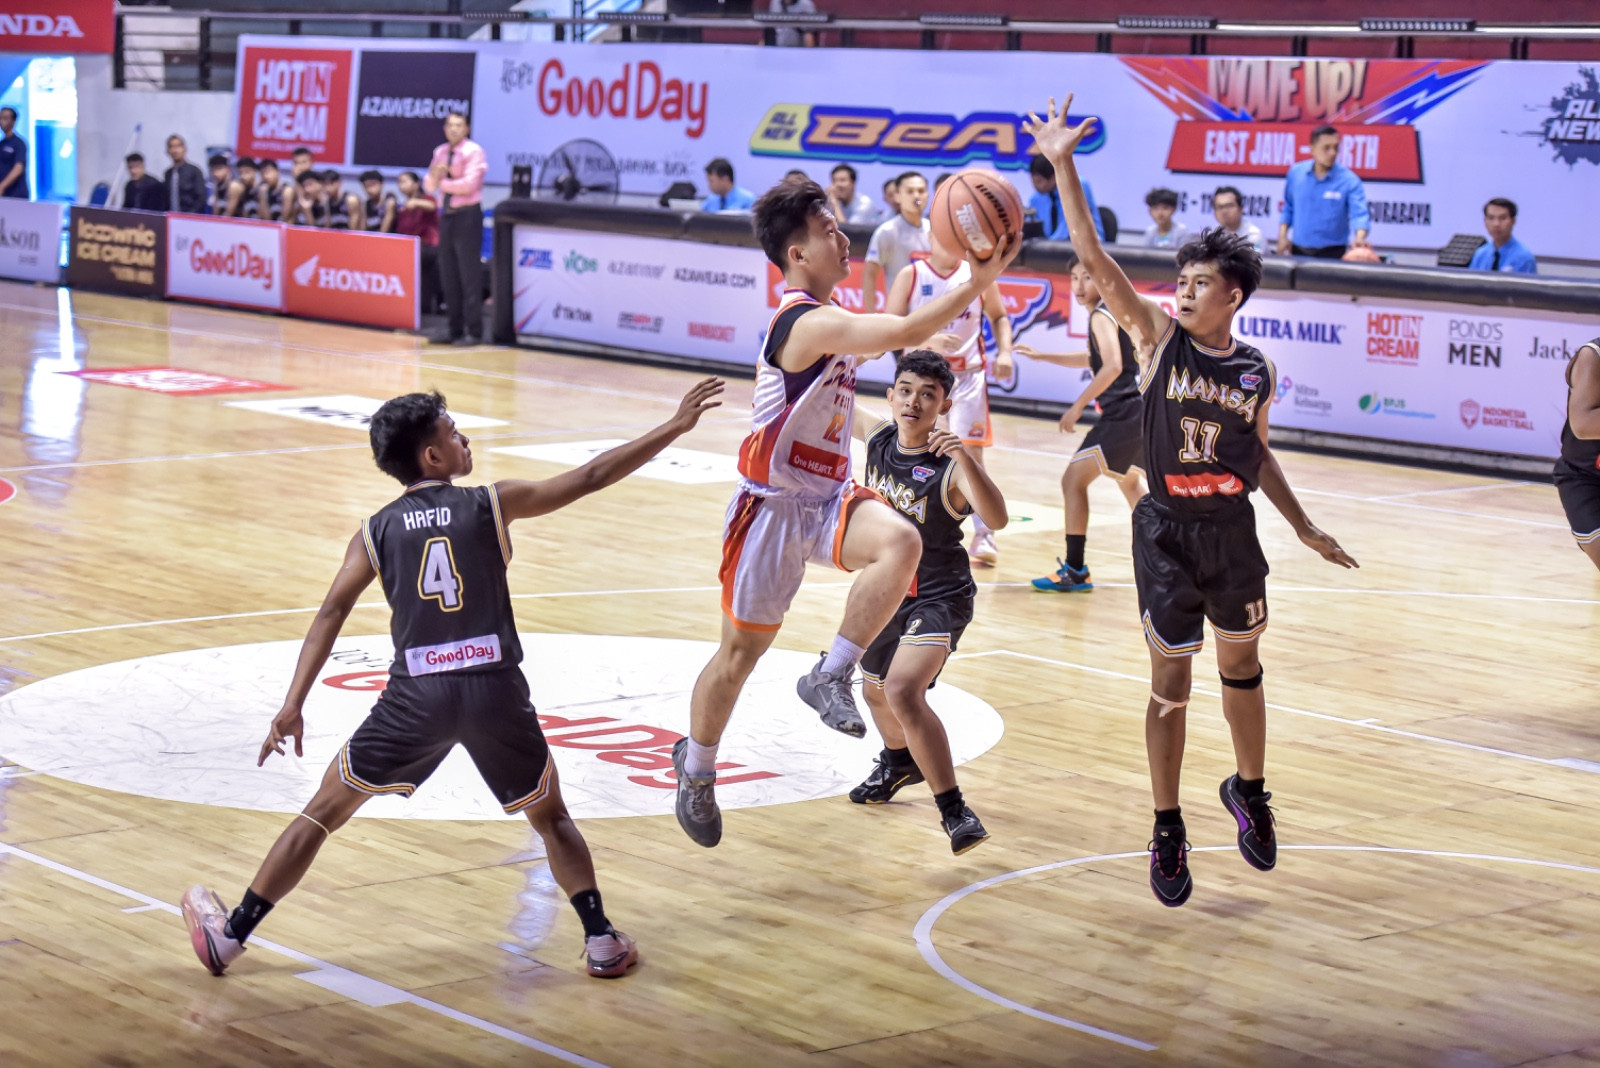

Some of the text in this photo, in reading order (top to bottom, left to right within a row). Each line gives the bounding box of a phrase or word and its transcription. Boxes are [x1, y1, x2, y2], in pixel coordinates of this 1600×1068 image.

[359, 96, 470, 119] AZAWEAR.COM
[769, 111, 798, 126] ALL
[1564, 99, 1600, 119] AL
[252, 102, 329, 142] CREAM
[760, 127, 798, 141] NEW
[1204, 130, 1249, 164] EAST
[1250, 132, 1296, 166] JAVA
[1337, 134, 1380, 170] RTH
[1367, 201, 1432, 226] SURABAYA
[317, 267, 405, 297] HONDA
[1238, 315, 1342, 345] ULTRA MILK
[1449, 319, 1503, 341] POND'S
[1366, 336, 1419, 360] CREAM
[1448, 341, 1502, 369] MEN
[1166, 364, 1259, 423] MANSA
[1482, 406, 1527, 419] INDONESIA
[1482, 416, 1535, 431] BASKETBALL
[1179, 416, 1221, 463] 11
[793, 454, 807, 468] One
[402, 506, 451, 531] HAFID
[417, 536, 464, 613] 4
[1245, 597, 1266, 628] 11
[905, 618, 923, 635] 2
